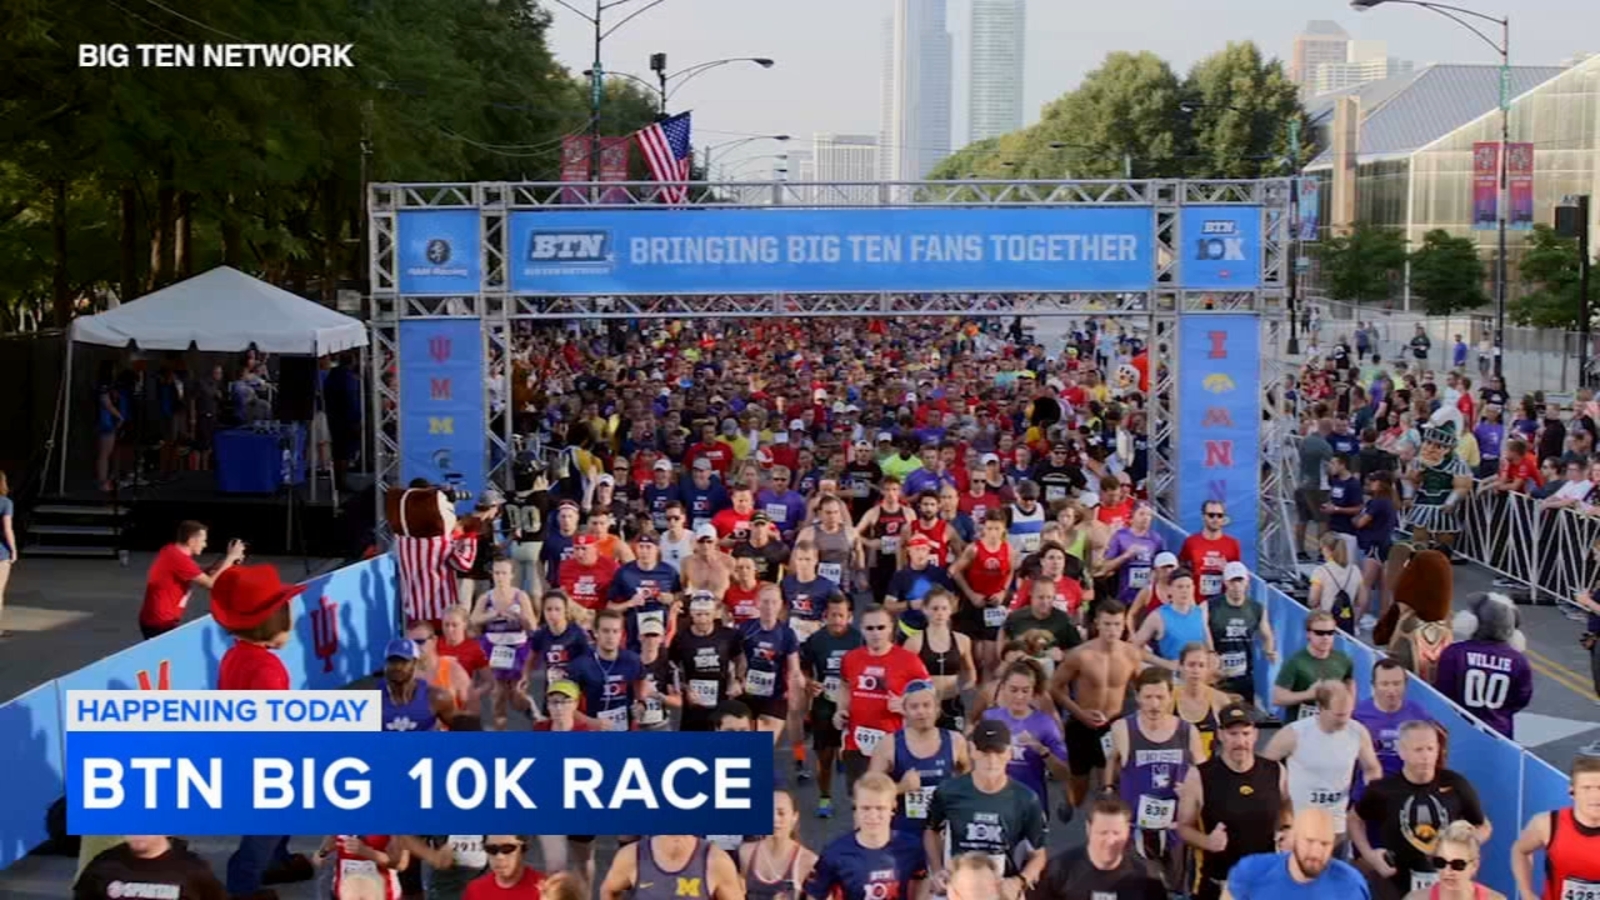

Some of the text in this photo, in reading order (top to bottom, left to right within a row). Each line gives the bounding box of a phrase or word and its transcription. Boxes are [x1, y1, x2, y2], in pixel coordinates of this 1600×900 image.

[531, 233, 605, 259] BTN
[630, 234, 1137, 264] BRINGING BIG TEN FANS TOGETHER
[1195, 238, 1246, 260] 10K
[430, 379, 452, 401] M
[428, 418, 454, 434] M
[1205, 441, 1232, 467] N
[1467, 651, 1511, 672] WILLIE
[1464, 669, 1510, 709] 00
[1310, 792, 1341, 804] 3847
[1145, 804, 1169, 816] 830
[966, 822, 1002, 841] 10K
[676, 878, 701, 896] M
